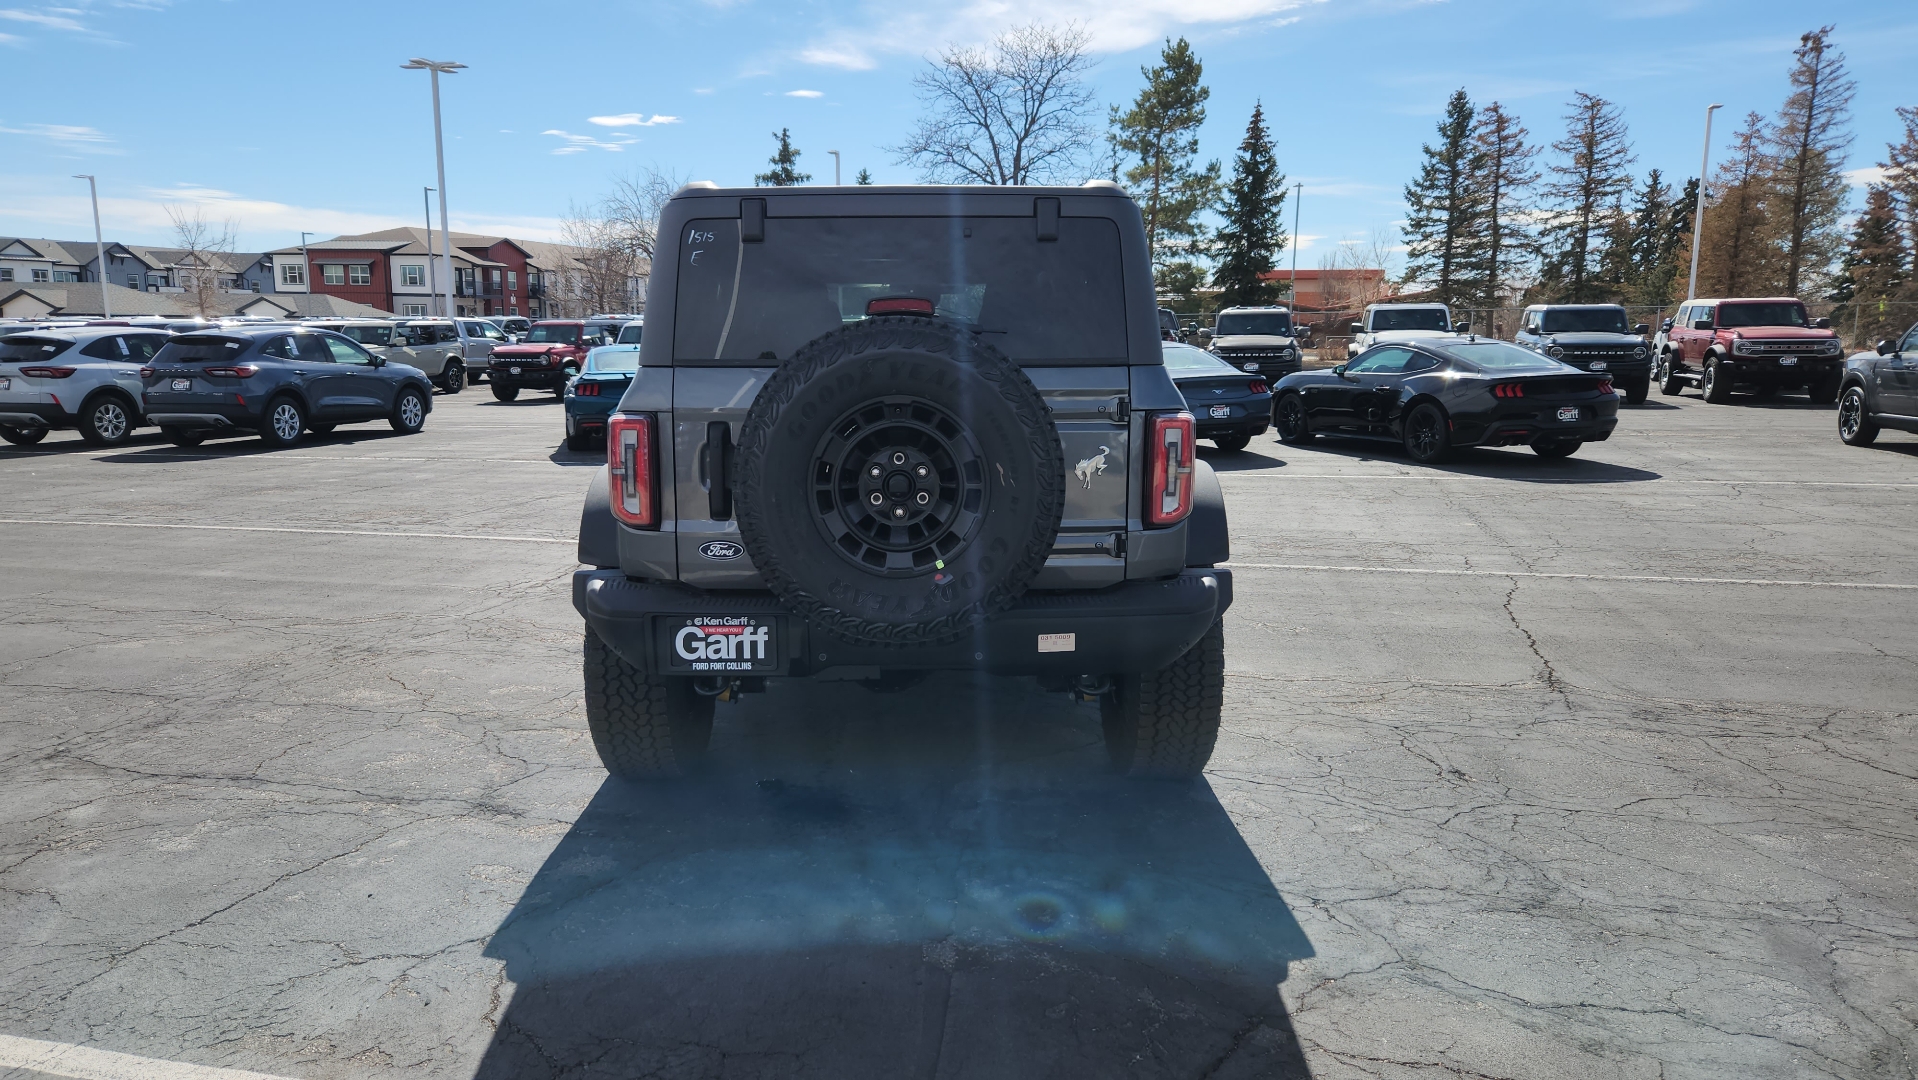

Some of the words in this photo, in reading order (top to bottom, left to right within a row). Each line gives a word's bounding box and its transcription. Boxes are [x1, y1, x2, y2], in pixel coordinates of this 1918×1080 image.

[171, 381, 190, 389] Garff
[1209, 406, 1230, 416] Garff
[1557, 408, 1579, 419] Garff
[707, 543, 735, 556] Ford
[703, 616, 723, 626] Ken
[724, 616, 749, 626] Garff
[675, 626, 769, 660] Garff
[692, 662, 709, 671] FORD
[710, 662, 725, 671] FORT
[726, 662, 752, 671] COLLINS
